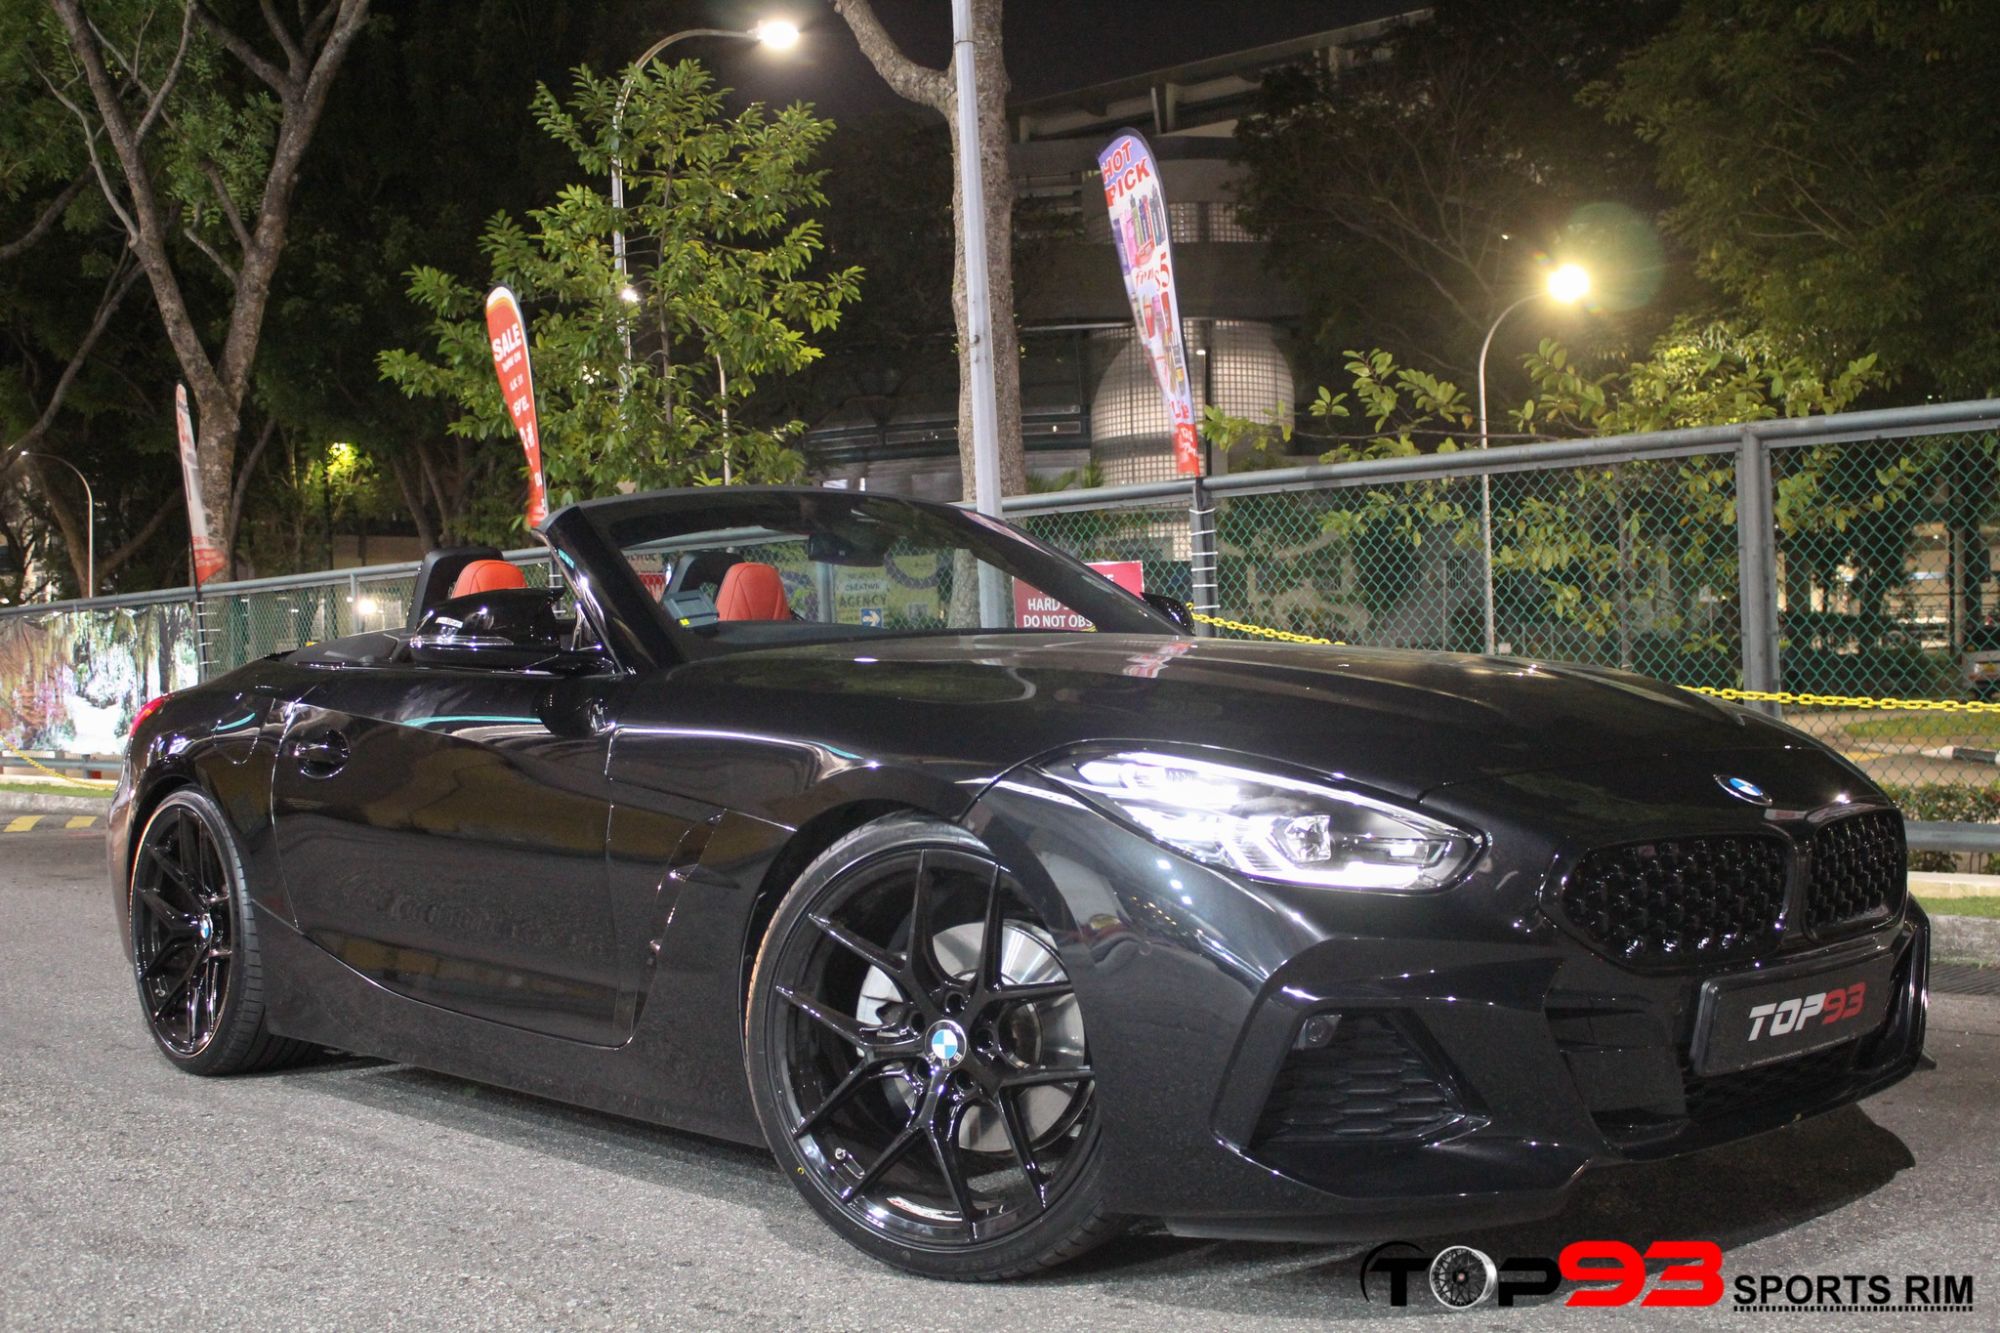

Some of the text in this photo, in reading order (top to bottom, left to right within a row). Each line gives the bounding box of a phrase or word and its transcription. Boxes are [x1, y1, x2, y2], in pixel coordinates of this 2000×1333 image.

[1103, 140, 1131, 184] HOT
[1104, 158, 1150, 208] PICK
[492, 323, 522, 362] SALE
[1023, 615, 1040, 628] DO
[1042, 615, 1066, 628] NOT
[1027, 597, 1061, 611] HARD
[1747, 982, 1867, 1041] TOP93
